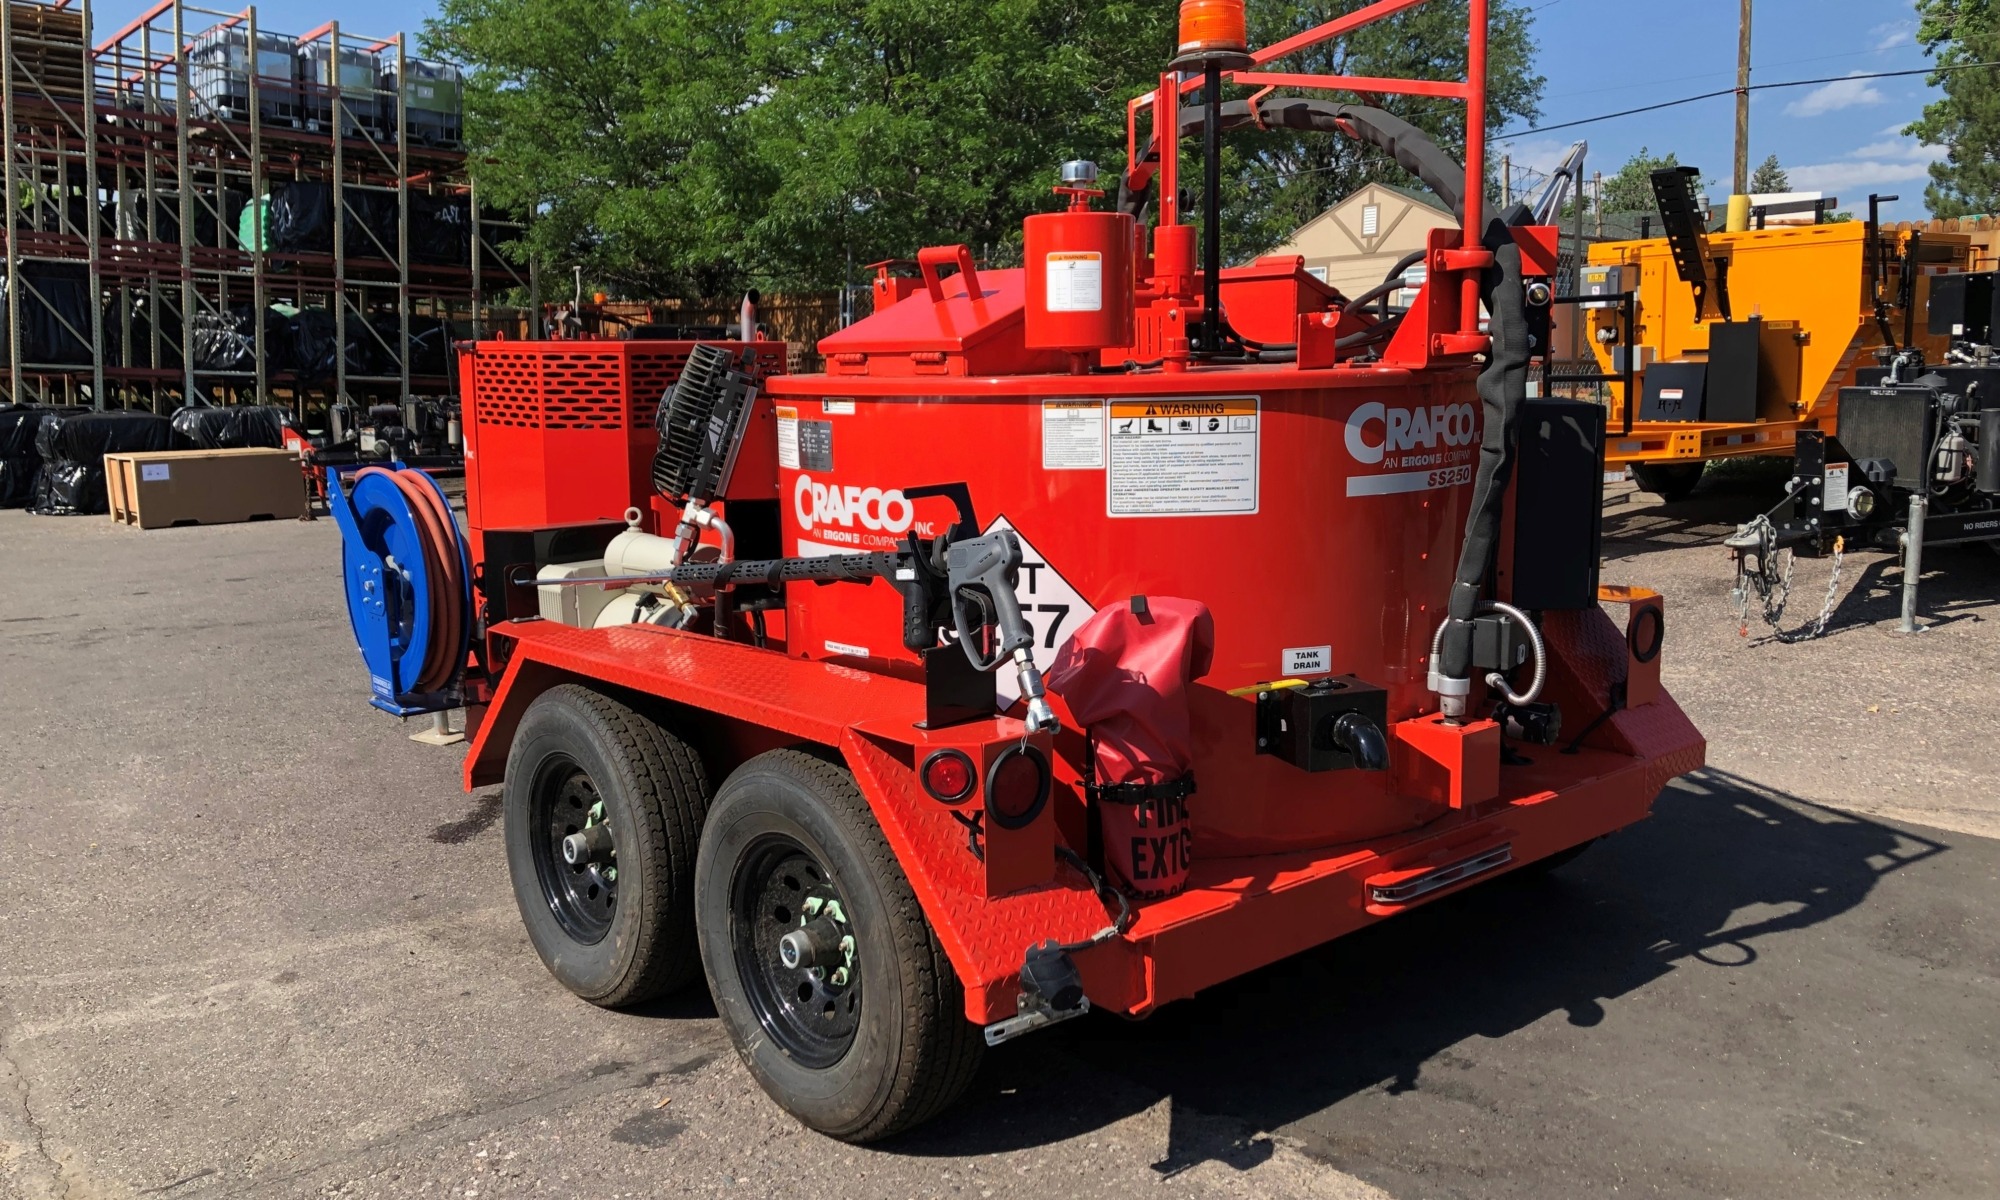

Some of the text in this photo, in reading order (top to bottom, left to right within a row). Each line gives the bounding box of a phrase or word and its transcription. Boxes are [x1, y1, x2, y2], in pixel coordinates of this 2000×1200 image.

[1160, 403, 1224, 415] WARNING
[1344, 401, 1475, 464] CRAFCO
[1383, 450, 1471, 469] AN ERGON COMPANY
[1428, 468, 1470, 487] SS250
[795, 474, 934, 535] CRAFCO INC
[1975, 520, 1998, 529] RIDERS
[812, 528, 821, 538] AN
[823, 529, 852, 543] ERGON
[1295, 651, 1319, 659] TANK
[1293, 661, 1321, 670] DRAIN
